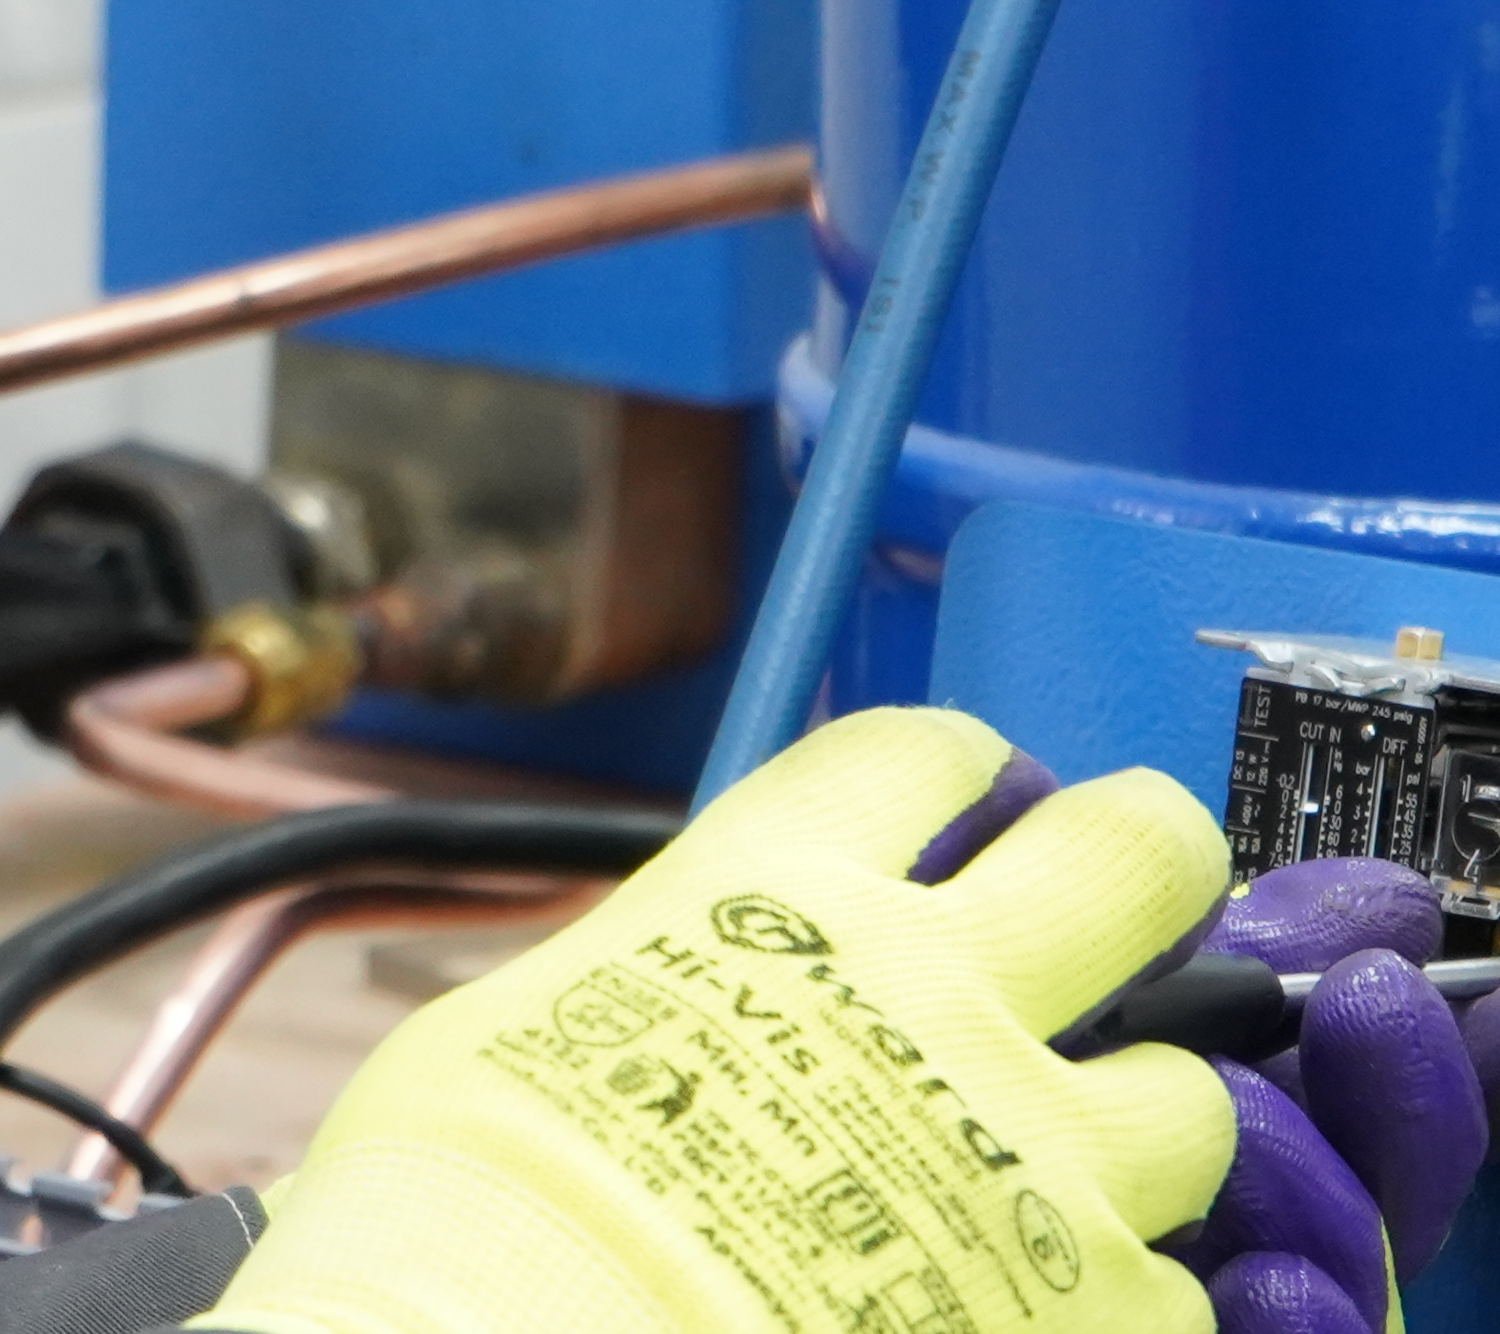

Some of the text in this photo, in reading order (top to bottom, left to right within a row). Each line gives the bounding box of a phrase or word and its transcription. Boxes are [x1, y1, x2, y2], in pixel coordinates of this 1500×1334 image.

[1254, 685, 1271, 727] TEST
[1313, 695, 1323, 705] 17
[1372, 706, 1391, 719] 245
[1300, 721, 1342, 743] CUT IN
[1382, 737, 1408, 755] DIFF
[1355, 761, 1371, 776] bar
[1406, 772, 1420, 786] psi
[1335, 784, 1344, 800] 6
[1356, 781, 1363, 796] 4
[1282, 790, 1289, 803] 0
[1405, 793, 1418, 809] 55
[1280, 805, 1288, 819] 2
[1334, 800, 1341, 815] 0
[1353, 804, 1361, 820] 3
[1329, 815, 1342, 830] 30
[1403, 809, 1416, 824] 45
[1277, 822, 1284, 835] 4
[1350, 828, 1358, 844] 2
[1401, 824, 1414, 840] 35
[1276, 839, 1283, 853] 6
[1327, 831, 1340, 847] 60
[1399, 840, 1412, 855] 25
[636, 936, 819, 1076] Hi-Vis
